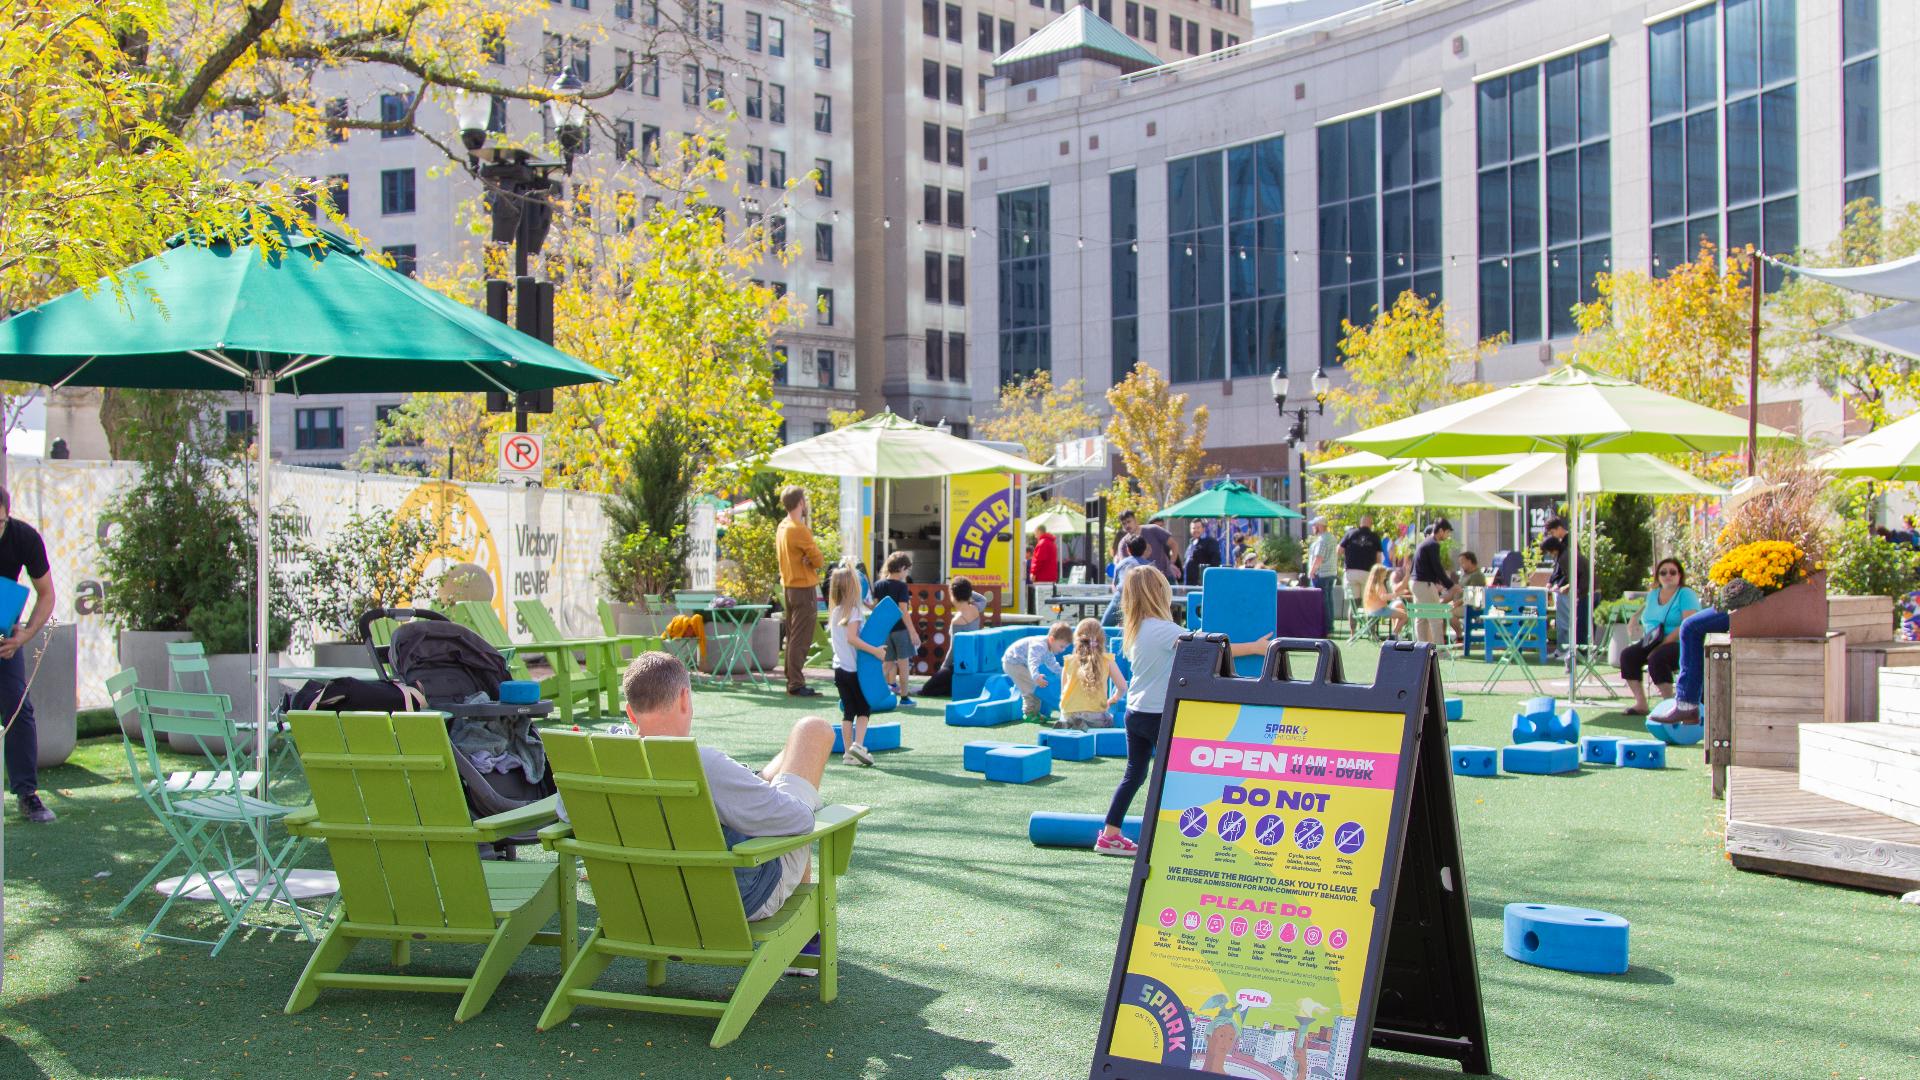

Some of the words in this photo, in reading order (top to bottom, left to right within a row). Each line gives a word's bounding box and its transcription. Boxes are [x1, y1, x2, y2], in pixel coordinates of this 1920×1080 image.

[516, 443, 531, 462] P
[515, 524, 558, 563] Victory
[515, 569, 549, 596] never
[1265, 723, 1300, 735] SPARK
[1190, 746, 1288, 774] OPEN
[1291, 753, 1303, 766] 11
[1306, 755, 1327, 768] AM
[1336, 757, 1376, 771] DARK
[1221, 785, 1271, 806] DO
[1275, 790, 1330, 813] NOT
[1253, 848, 1278, 856] Consume
[1254, 855, 1275, 863] outside
[1168, 866, 1181, 874] WE
[1182, 868, 1220, 879] RESERVE
[1221, 872, 1237, 881] THE
[1238, 874, 1264, 883] RIGHT
[1265, 877, 1276, 885] TO
[1278, 879, 1295, 887] ASK
[1298, 881, 1315, 890] YOU
[1317, 883, 1328, 891] TO
[1330, 885, 1358, 894] LEAVE
[1291, 865, 1322, 873] skateboard
[1177, 876, 1202, 884] REFUSE
[1203, 879, 1242, 889] ADMISSION
[1257, 884, 1319, 897] NON-COMMUNITY
[1320, 892, 1358, 902] BEHAVIOR.
[1199, 893, 1277, 915] PLEASE
[1280, 903, 1312, 919] DO
[1271, 952, 1297, 960] walkways
[1239, 993, 1268, 1004] FUN.
[1138, 983, 1186, 1053] SPARK
